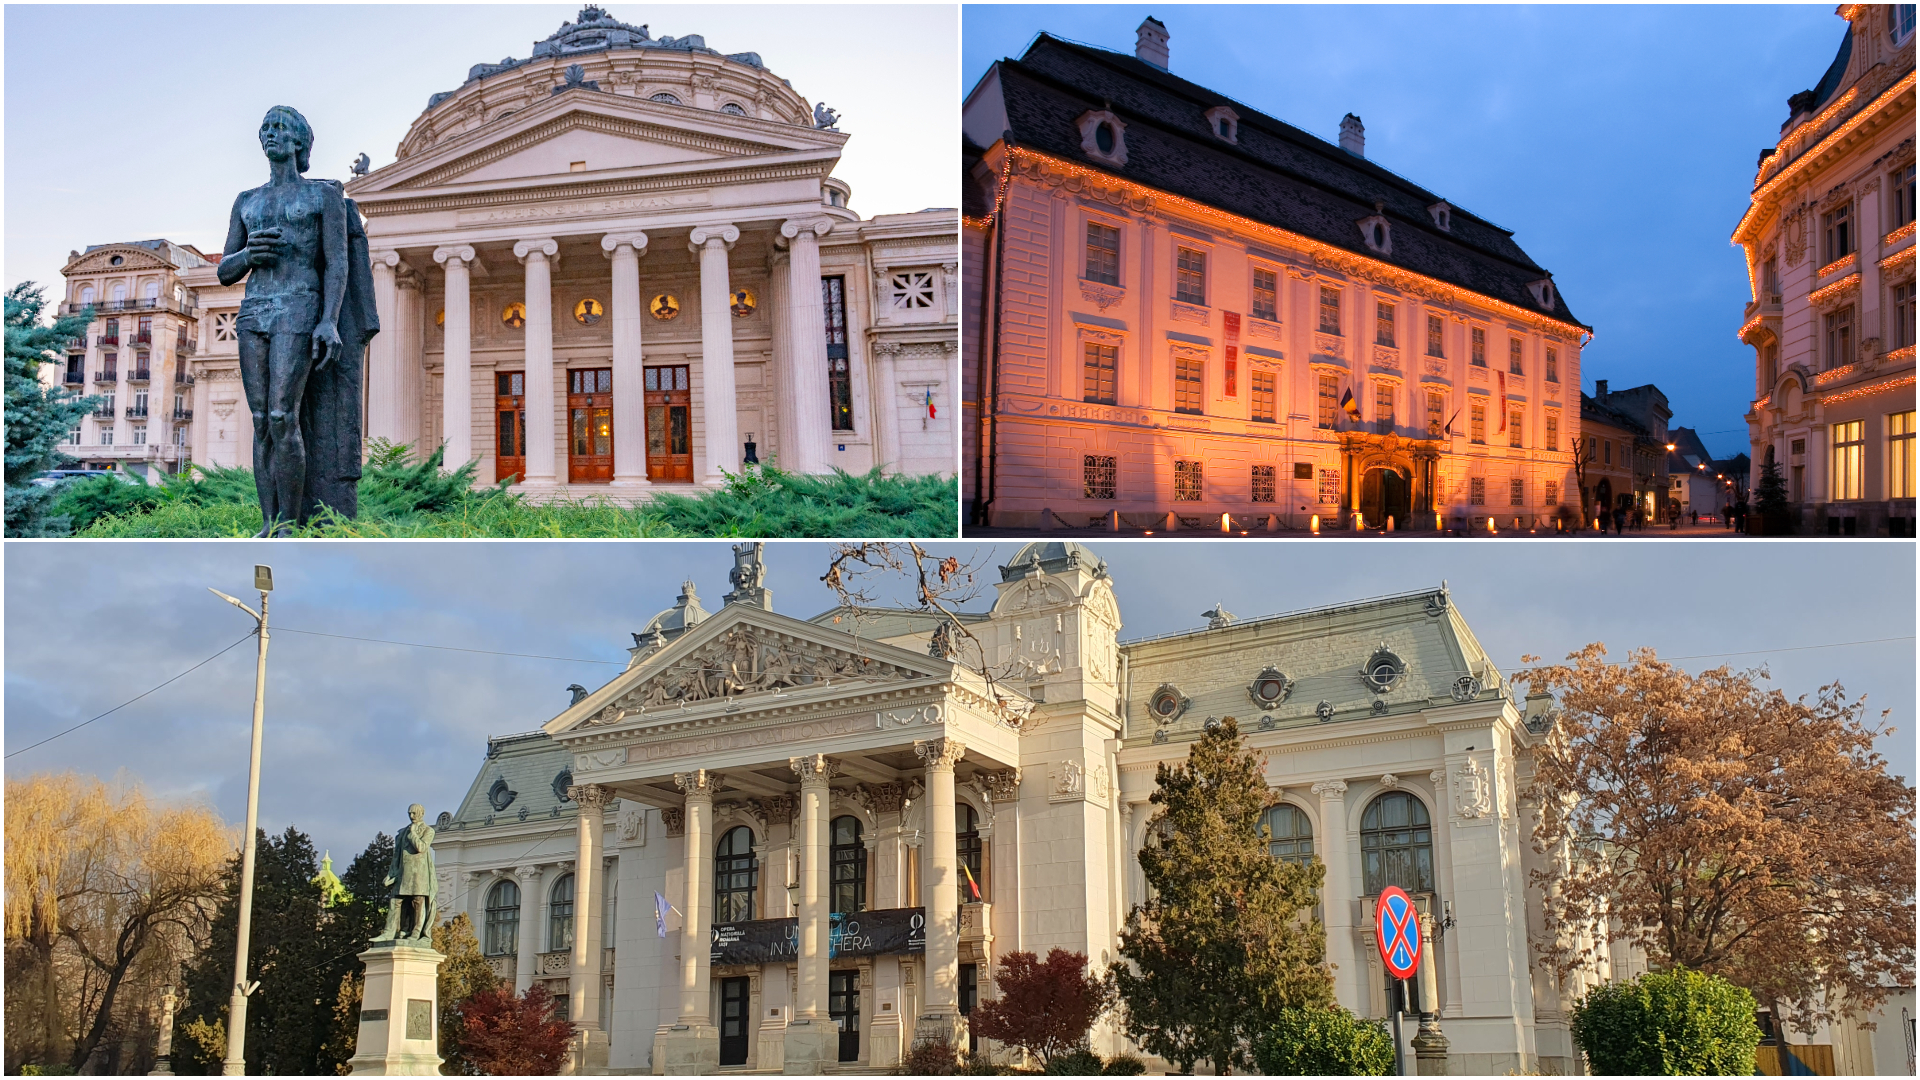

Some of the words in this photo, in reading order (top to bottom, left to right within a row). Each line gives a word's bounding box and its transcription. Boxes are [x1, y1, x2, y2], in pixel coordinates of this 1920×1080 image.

[488, 203, 593, 221] ATHENEUL
[602, 196, 675, 211] ROMAN
[642, 735, 739, 759] TEATRUL
[747, 717, 863, 746] NATIONAL
[830, 921, 860, 937] LLO
[770, 941, 784, 956] IN
